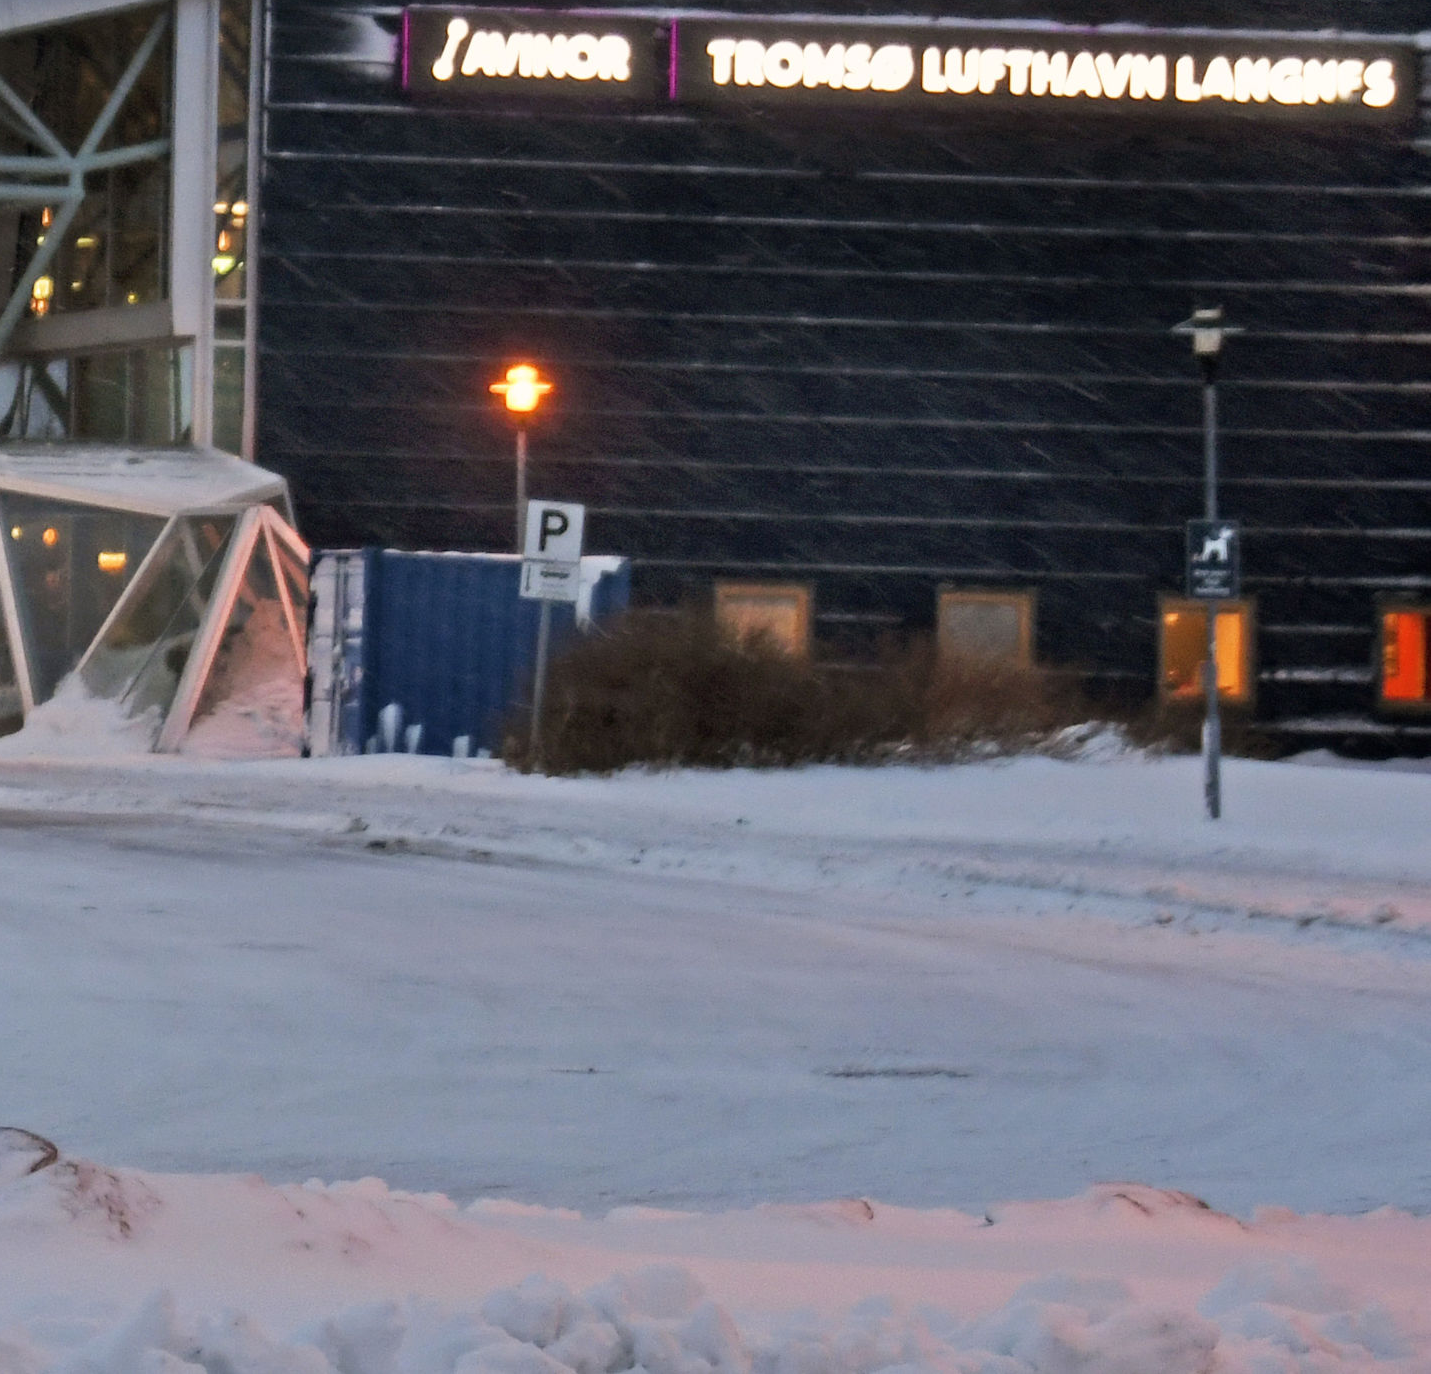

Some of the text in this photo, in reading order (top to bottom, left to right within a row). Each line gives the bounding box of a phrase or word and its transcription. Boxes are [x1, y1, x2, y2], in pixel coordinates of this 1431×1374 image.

[461, 30, 631, 82] AVINOR
[706, 38, 914, 92] TROMSØ
[921, 46, 1167, 101] LUFTHAVN
[538, 509, 569, 552] P
